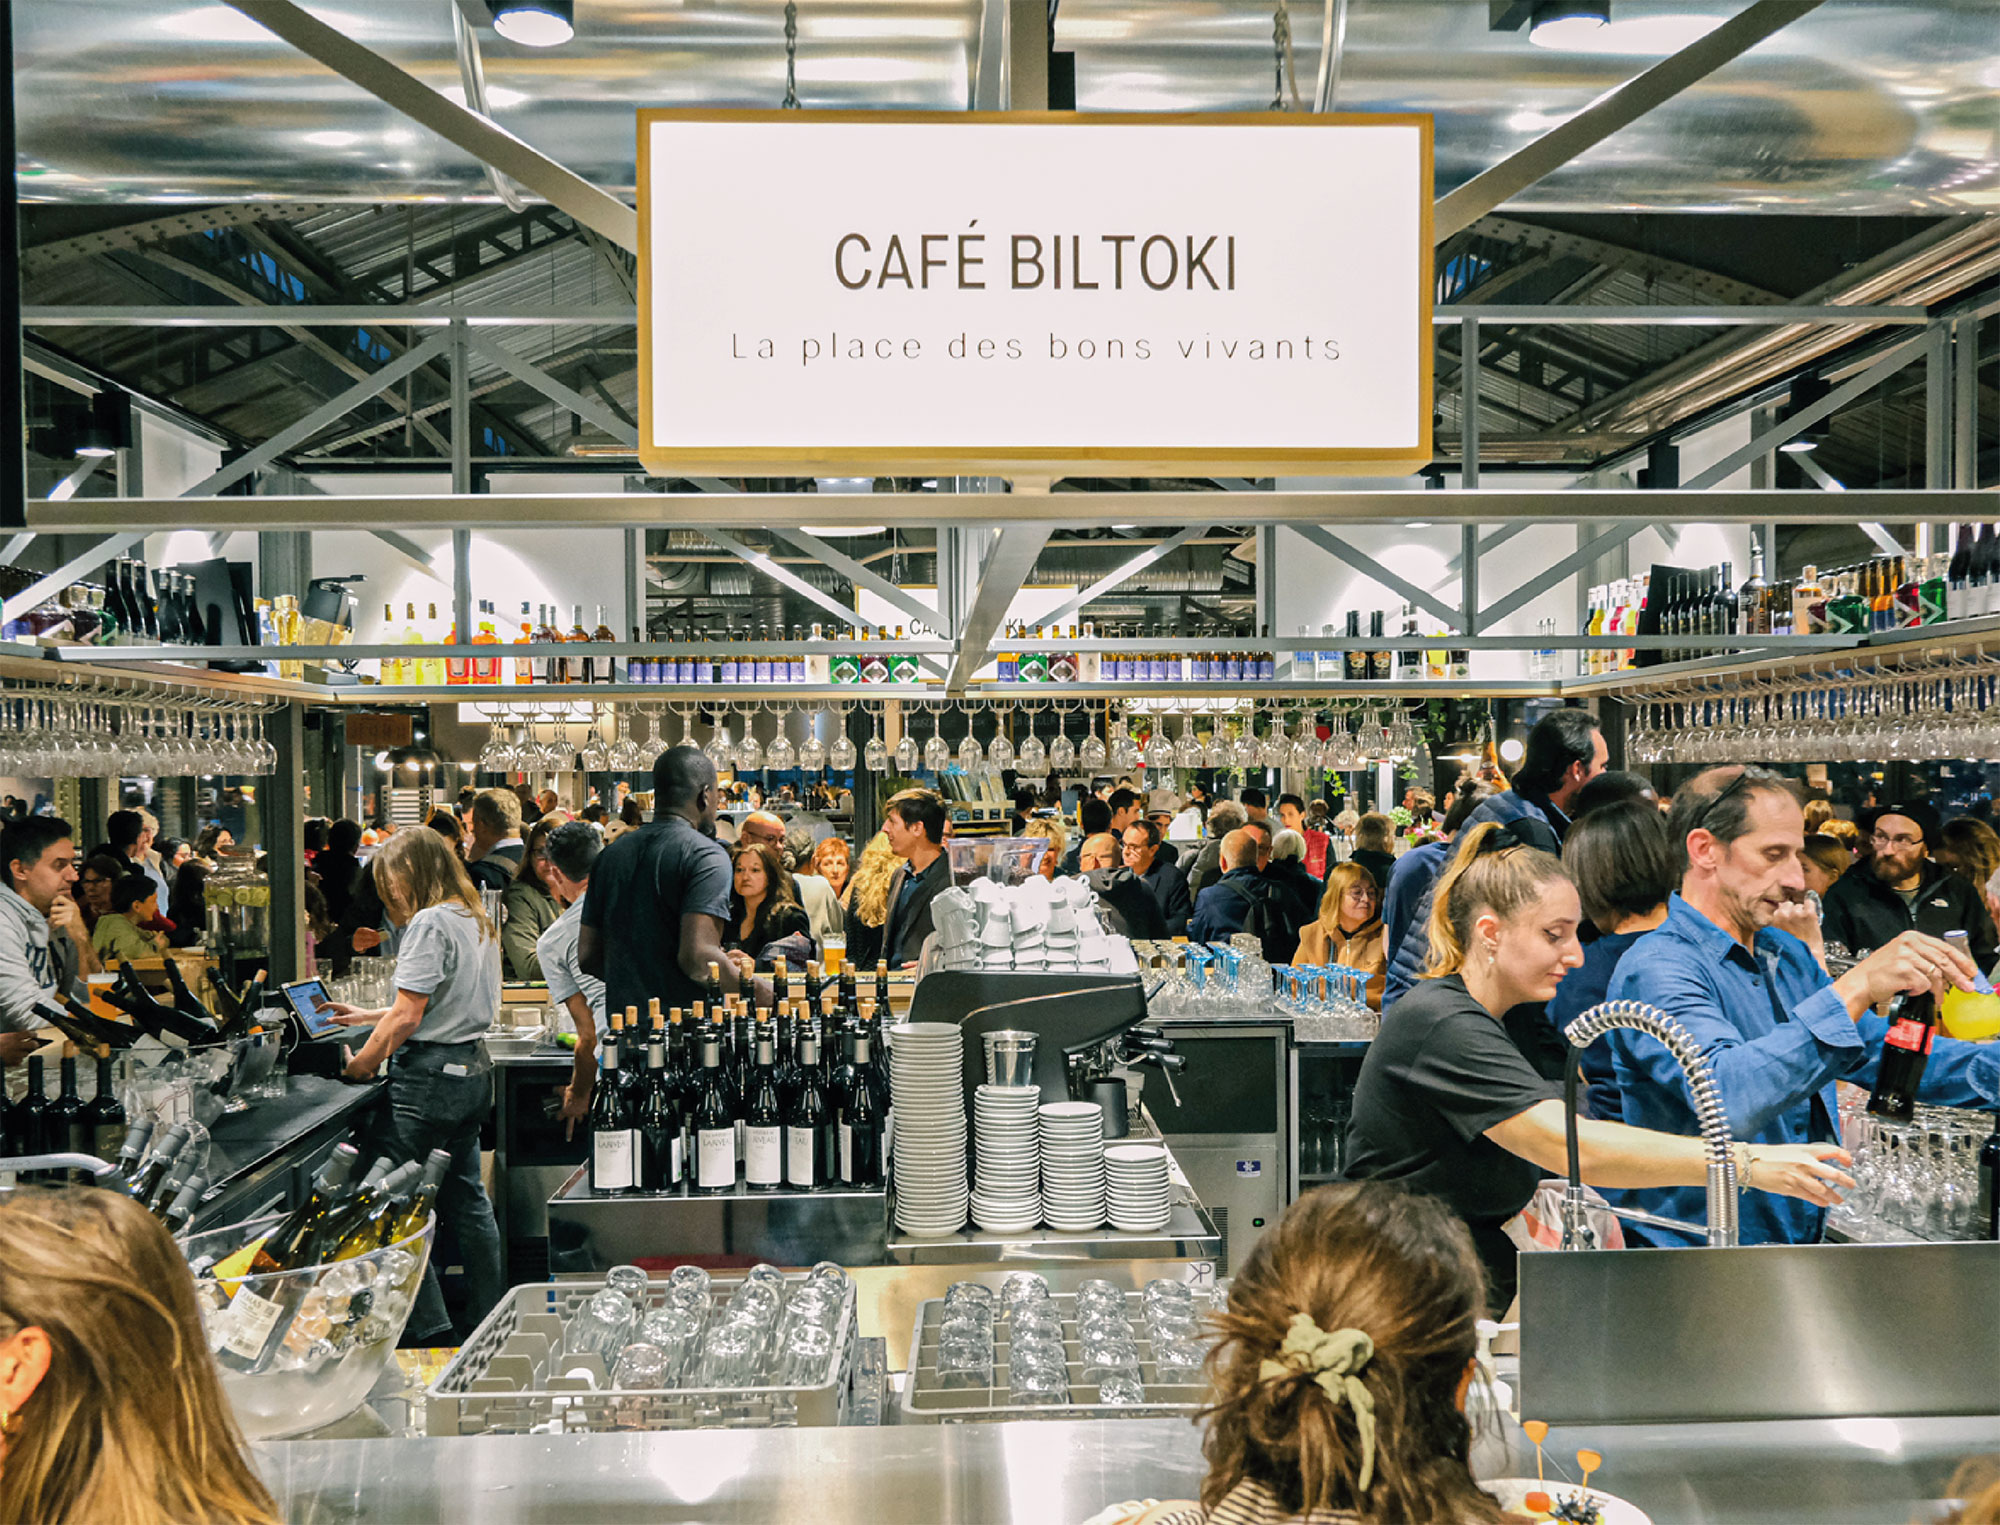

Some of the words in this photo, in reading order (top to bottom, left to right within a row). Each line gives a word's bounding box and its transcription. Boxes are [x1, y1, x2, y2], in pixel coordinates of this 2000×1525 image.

[834, 218, 986, 291] CAFÉ
[1010, 234, 1236, 292] BILTOKI
[732, 332, 774, 359] La
[802, 331, 921, 367] place
[947, 332, 1023, 360] des
[1049, 332, 1151, 360] bons
[1177, 332, 1340, 361] vivants
